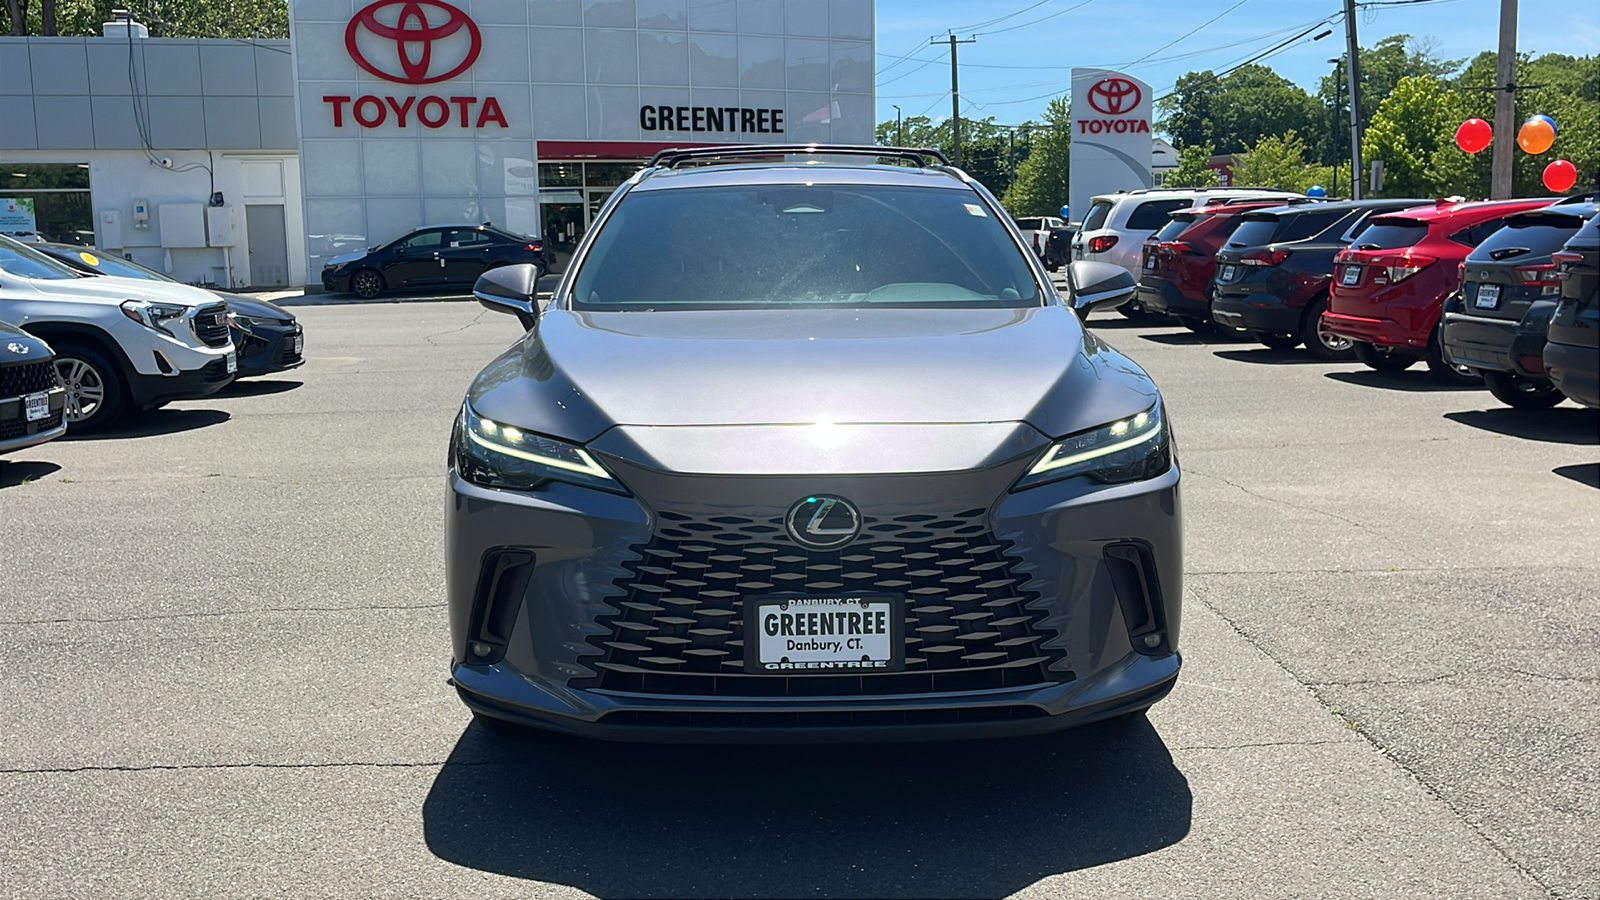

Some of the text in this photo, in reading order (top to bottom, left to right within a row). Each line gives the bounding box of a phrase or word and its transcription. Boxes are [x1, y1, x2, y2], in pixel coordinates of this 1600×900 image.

[323, 95, 509, 128] TOYOTA
[640, 105, 784, 133] GREENTREE
[1077, 119, 1150, 134] TOYOTA
[764, 611, 886, 636] GREENTREE
[787, 638, 863, 653] Danbury, CT.
[765, 660, 887, 669] GREENTREE
